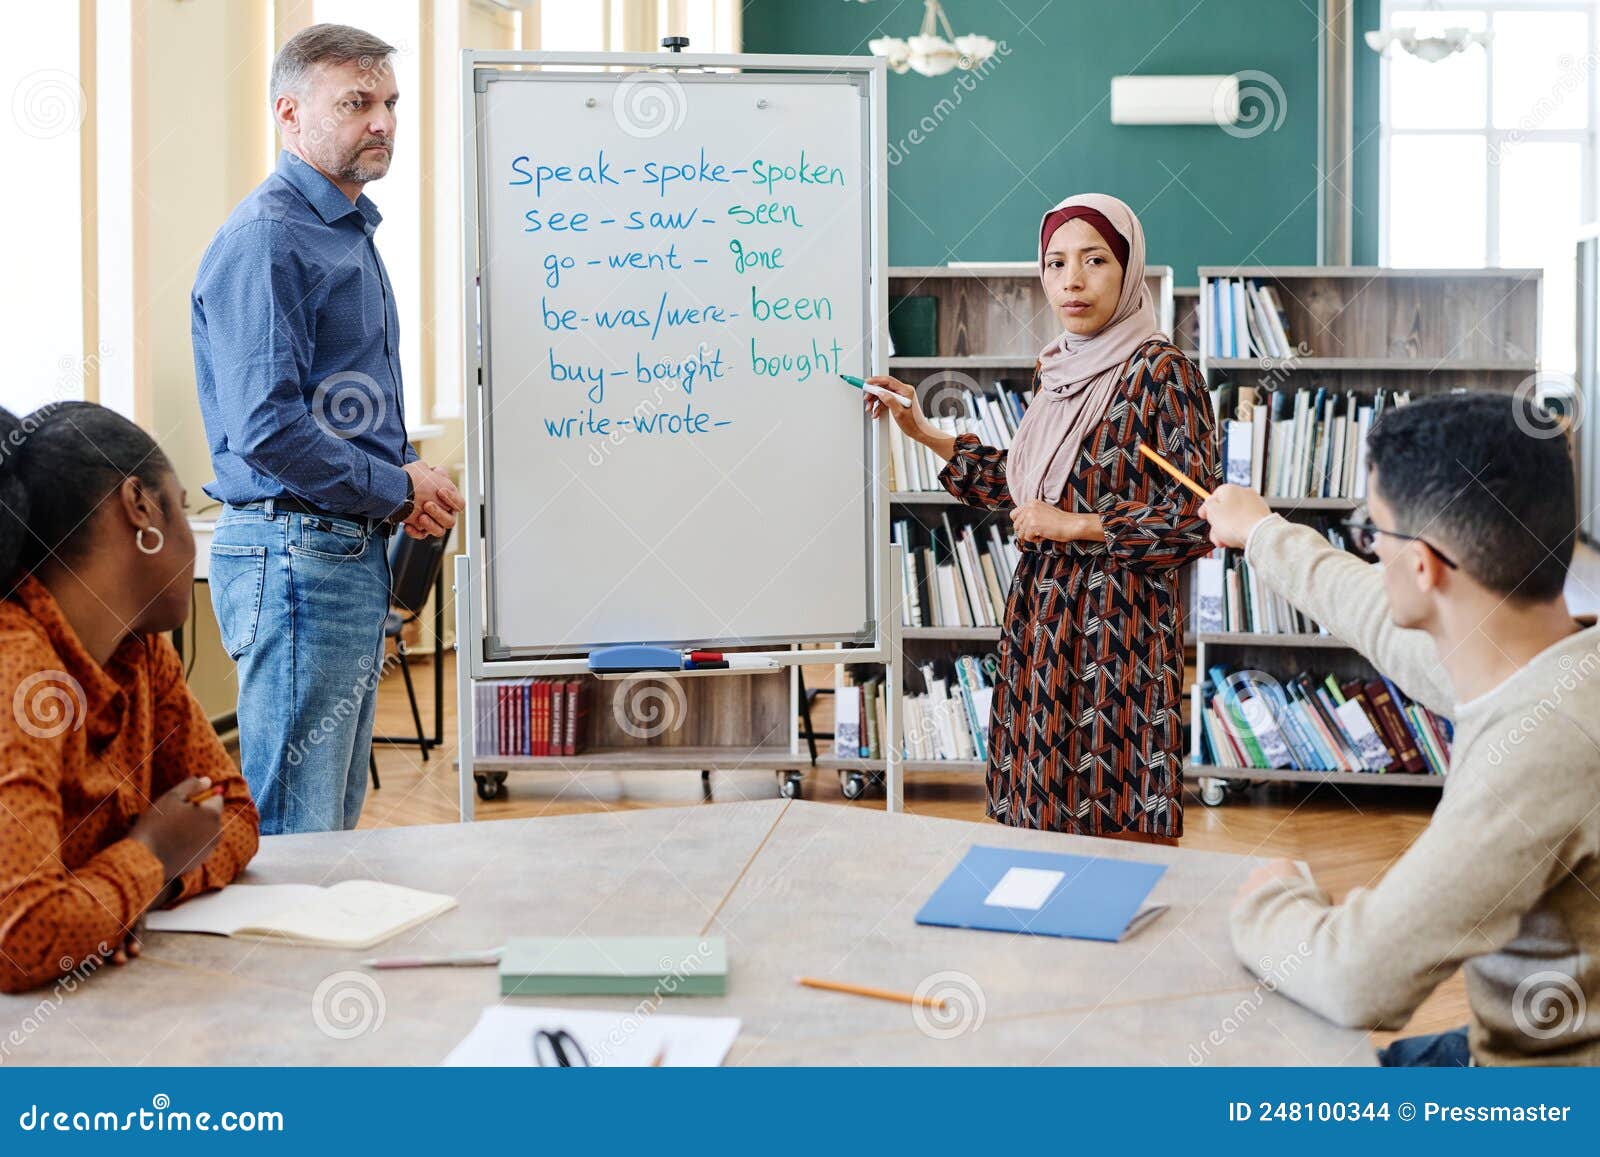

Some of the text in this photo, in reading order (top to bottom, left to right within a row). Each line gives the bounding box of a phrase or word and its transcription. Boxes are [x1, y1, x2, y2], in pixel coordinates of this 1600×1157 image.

[524, 208, 589, 233] see
[623, 207, 698, 232] saw
[728, 202, 804, 228] seen
[543, 253, 576, 289] go
[608, 243, 683, 271] went
[729, 239, 785, 275] gone
[751, 285, 833, 322] been
[751, 337, 844, 383] bought
